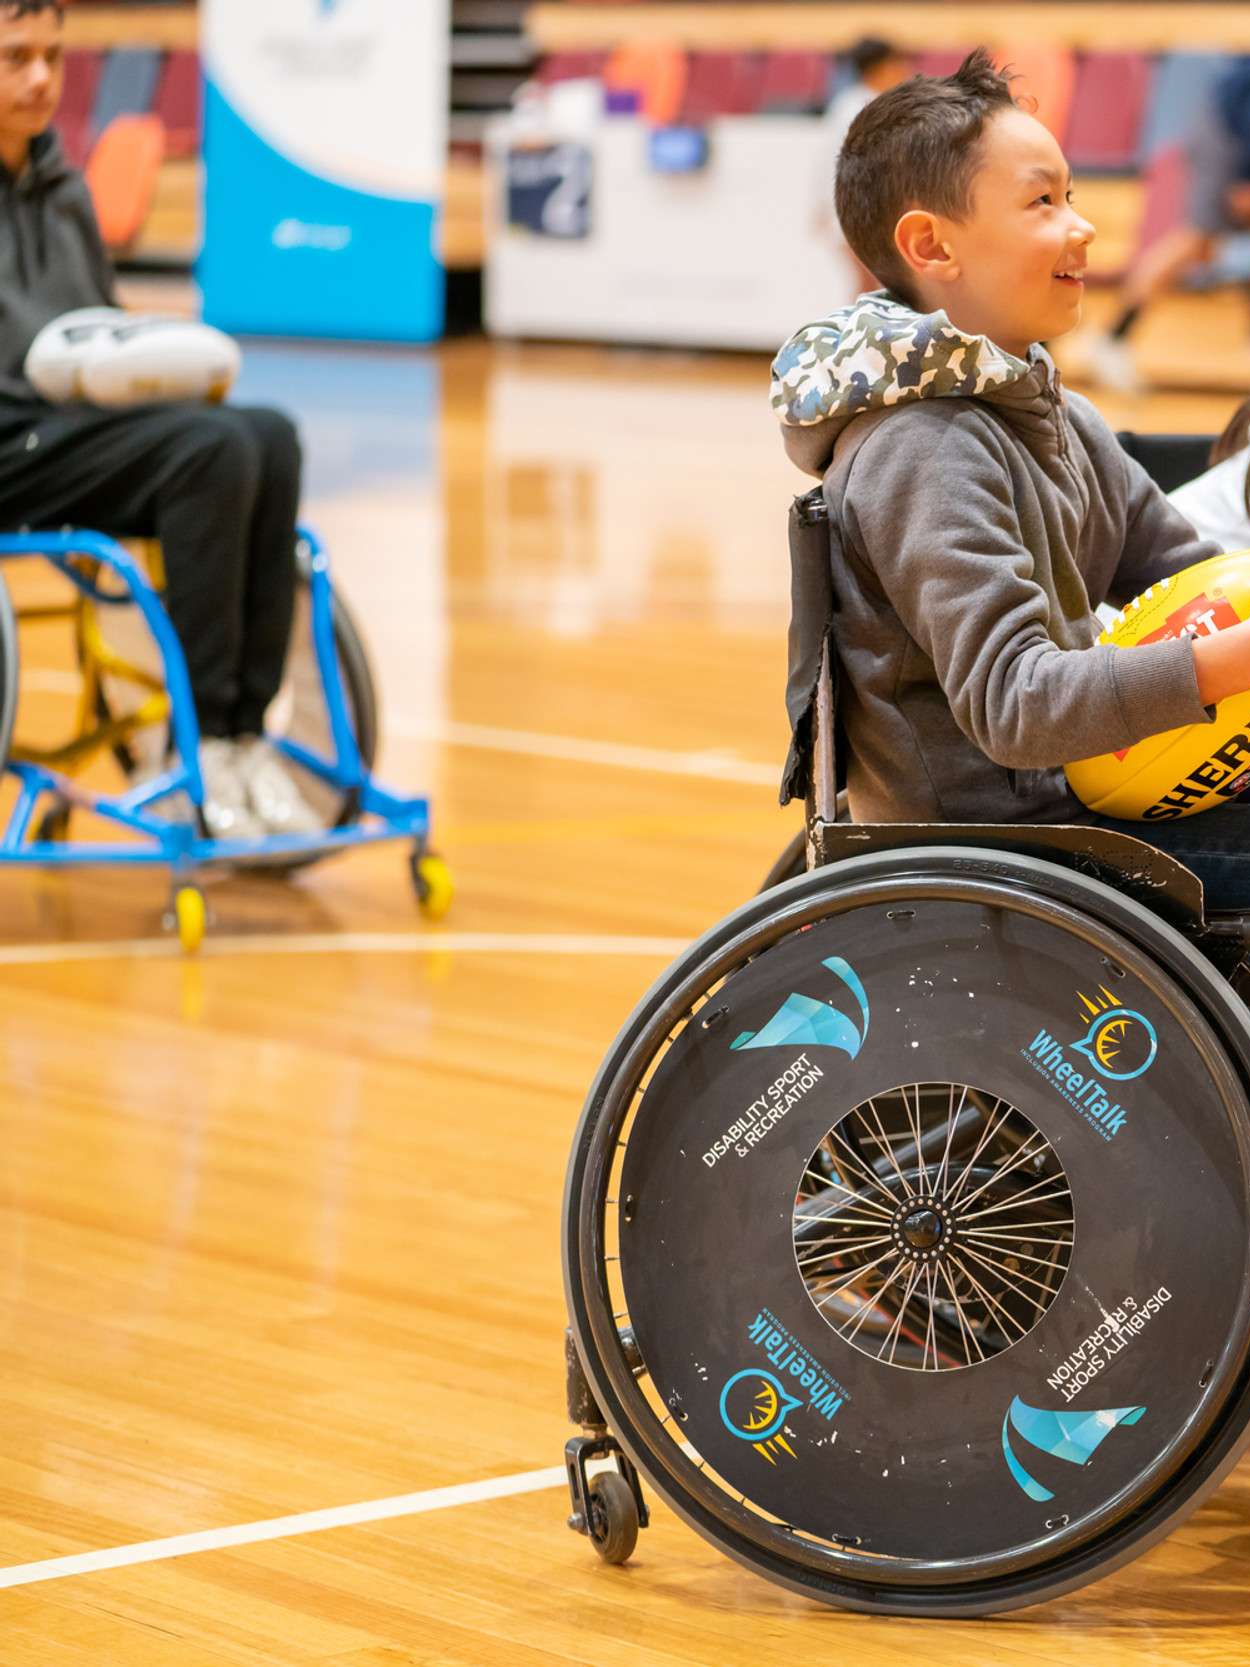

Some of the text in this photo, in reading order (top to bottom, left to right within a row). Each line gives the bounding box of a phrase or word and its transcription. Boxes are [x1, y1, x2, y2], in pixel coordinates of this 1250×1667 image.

[702, 1053, 811, 1167] DISABILITY SPORT
[734, 1065, 824, 1158] & RECREATION
[1020, 1049, 1112, 1142] INCLUSION AWARENESS PROGRAM
[1029, 1029, 1128, 1136] WheelTalk
[748, 1313, 844, 1421] WheelTalk
[762, 1307, 851, 1401] INCLUSION AWARENESS PROGRAM
[1046, 1295, 1138, 1390] & RECREATION
[1060, 1286, 1173, 1403] DISABILITY SPORT
